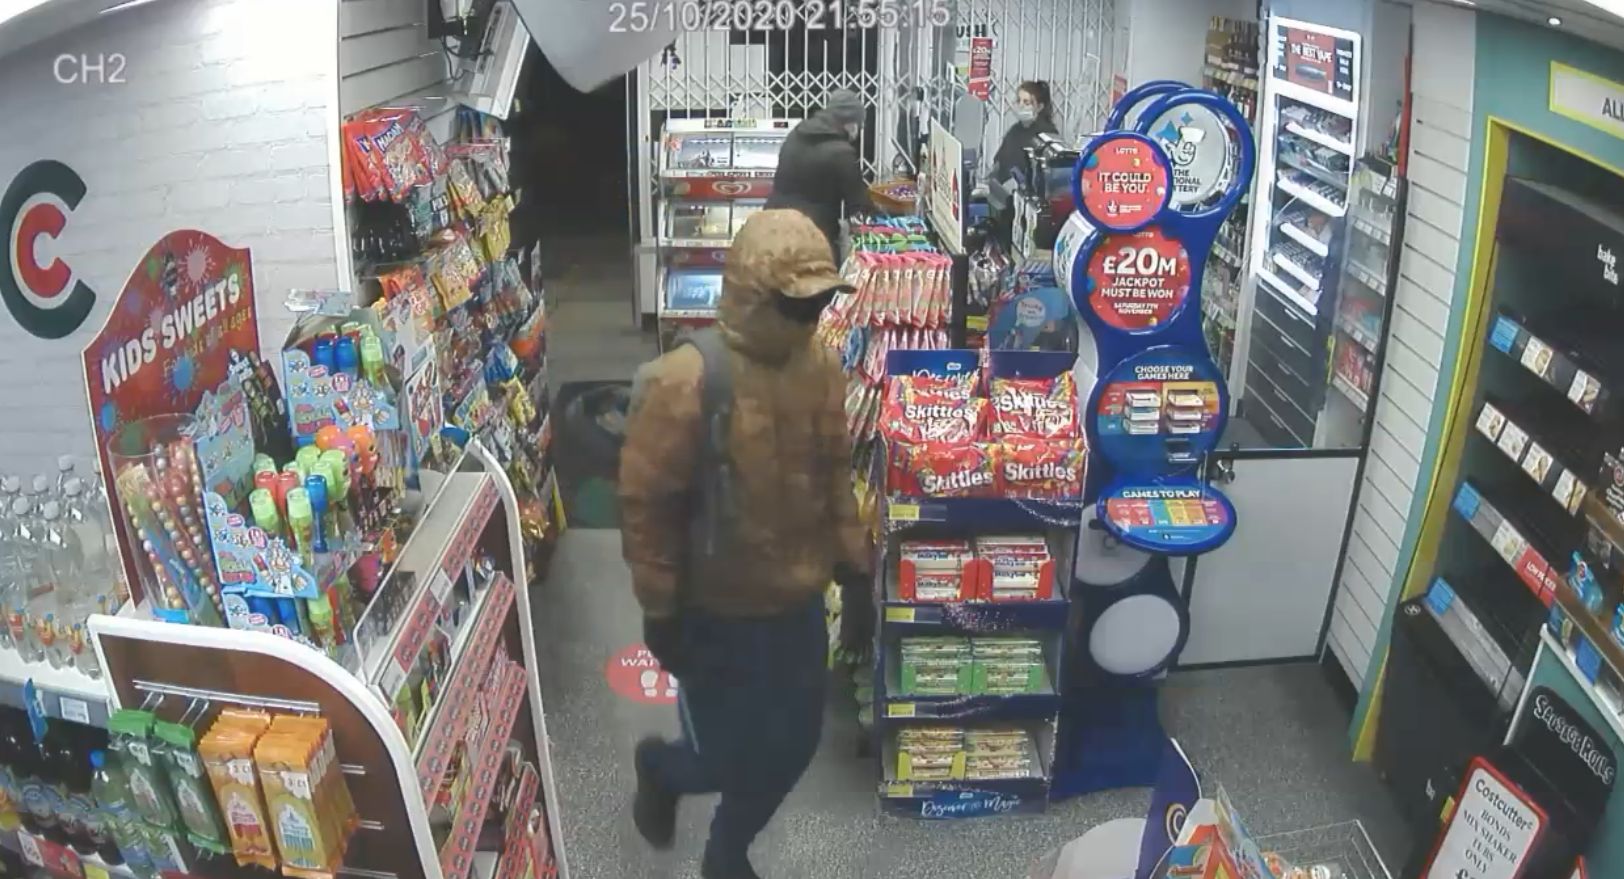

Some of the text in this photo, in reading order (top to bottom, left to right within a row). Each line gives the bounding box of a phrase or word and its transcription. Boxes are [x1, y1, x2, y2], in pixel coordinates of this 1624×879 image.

[956, 24, 987, 38] USH
[1099, 172, 1152, 183] IT COULD
[1174, 169, 1190, 177] THE
[1174, 177, 1201, 185] IONAL
[1104, 183, 1146, 193] BE YOU
[1103, 246, 1177, 276] £20M
[1112, 277, 1165, 288] JACKPOT
[1101, 288, 1174, 299] MUST BE WON
[101, 272, 241, 395] KIDS SWEETS
[1135, 365, 1194, 373] CHOOSE YOUR
[1137, 372, 1190, 380] GAMES HERE
[905, 404, 976, 419] Skittles
[1005, 463, 1077, 482] Skittles
[922, 469, 994, 493] Skittles
[1122, 490, 1201, 498] GAMES TO PLAY
[621, 657, 655, 667] WAI
[1480, 809, 1512, 842] BONDS
[1480, 827, 1518, 863] SHAKER
[1465, 849, 1488, 874] ONLY
